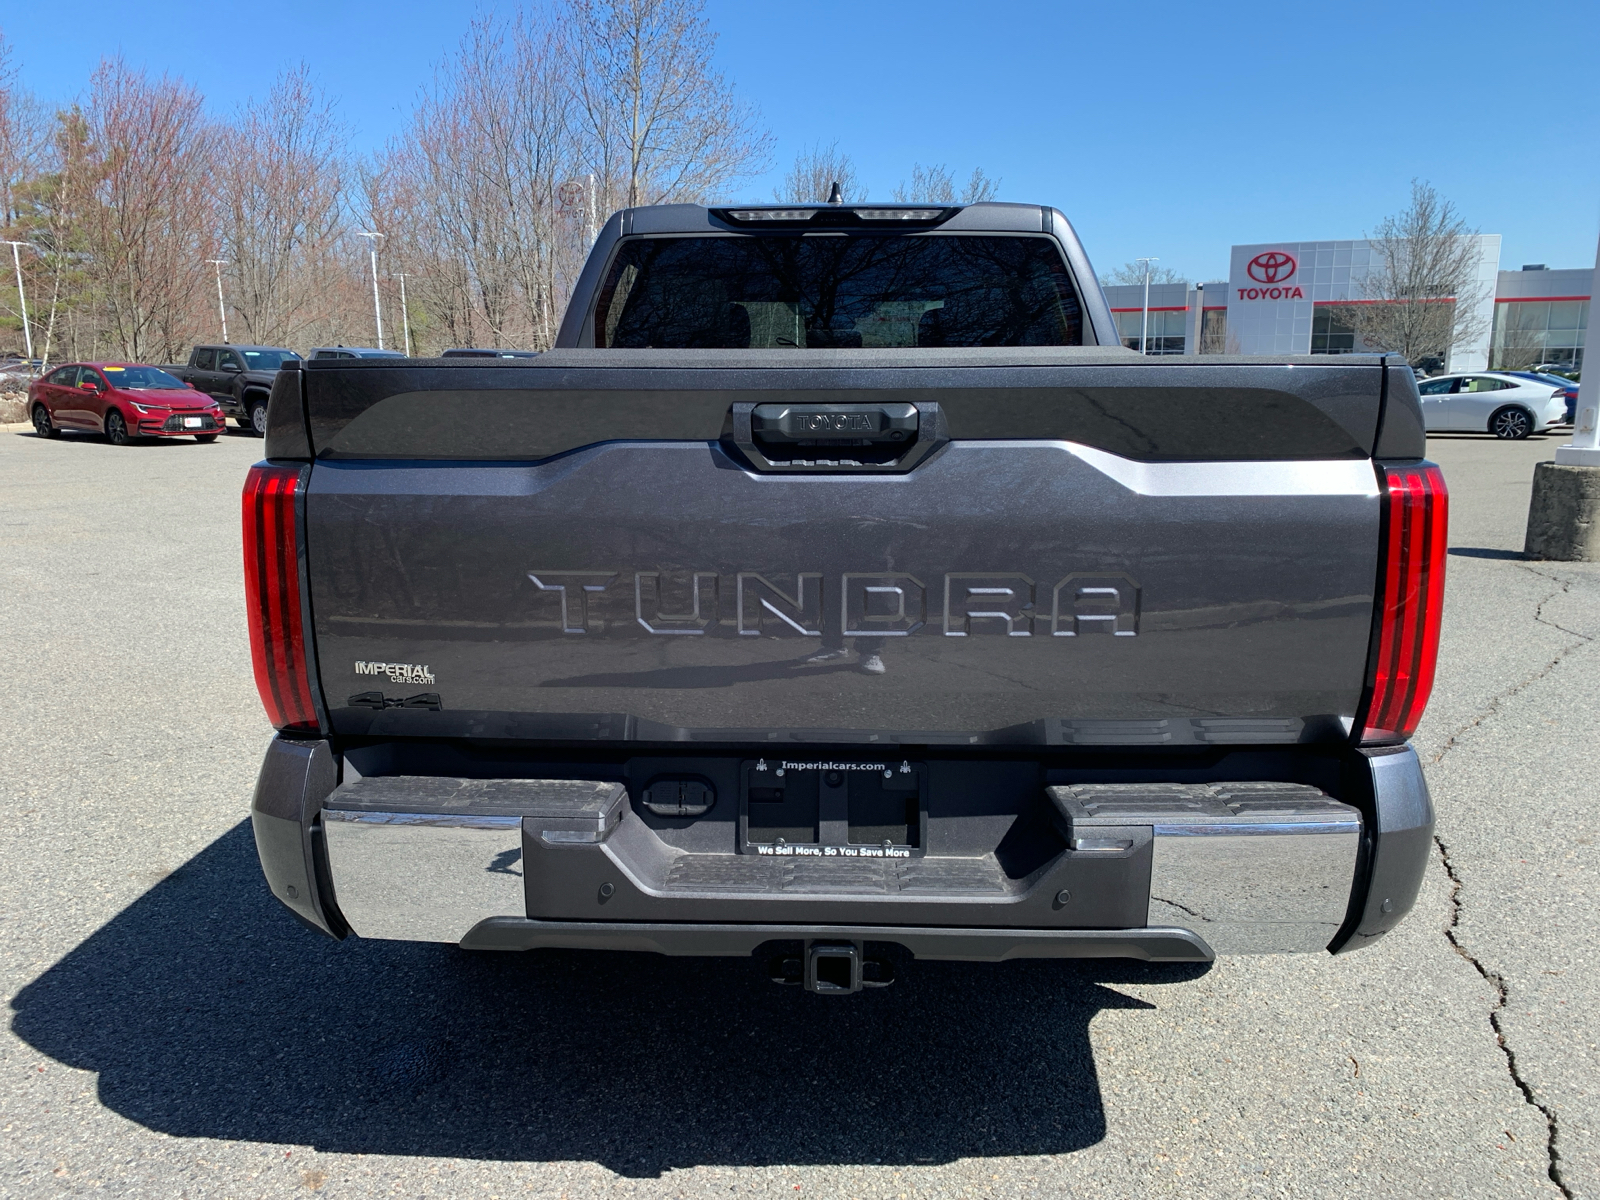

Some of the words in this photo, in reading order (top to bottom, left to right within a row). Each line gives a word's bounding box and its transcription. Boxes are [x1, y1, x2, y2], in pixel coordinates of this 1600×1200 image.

[1237, 286, 1303, 301] TOYOTA
[797, 414, 873, 431] TOYOTA
[526, 570, 1143, 638] TUNDRA
[354, 660, 436, 679] IMPERIAL
[390, 675, 436, 685] cars.com
[781, 760, 886, 771] Imperialcars.com
[757, 846, 774, 855] We
[775, 846, 793, 855] Sell
[795, 846, 822, 857] More,
[824, 847, 838, 856] So
[839, 847, 858, 856] You
[859, 847, 883, 857] Save
[885, 848, 910, 857] More
